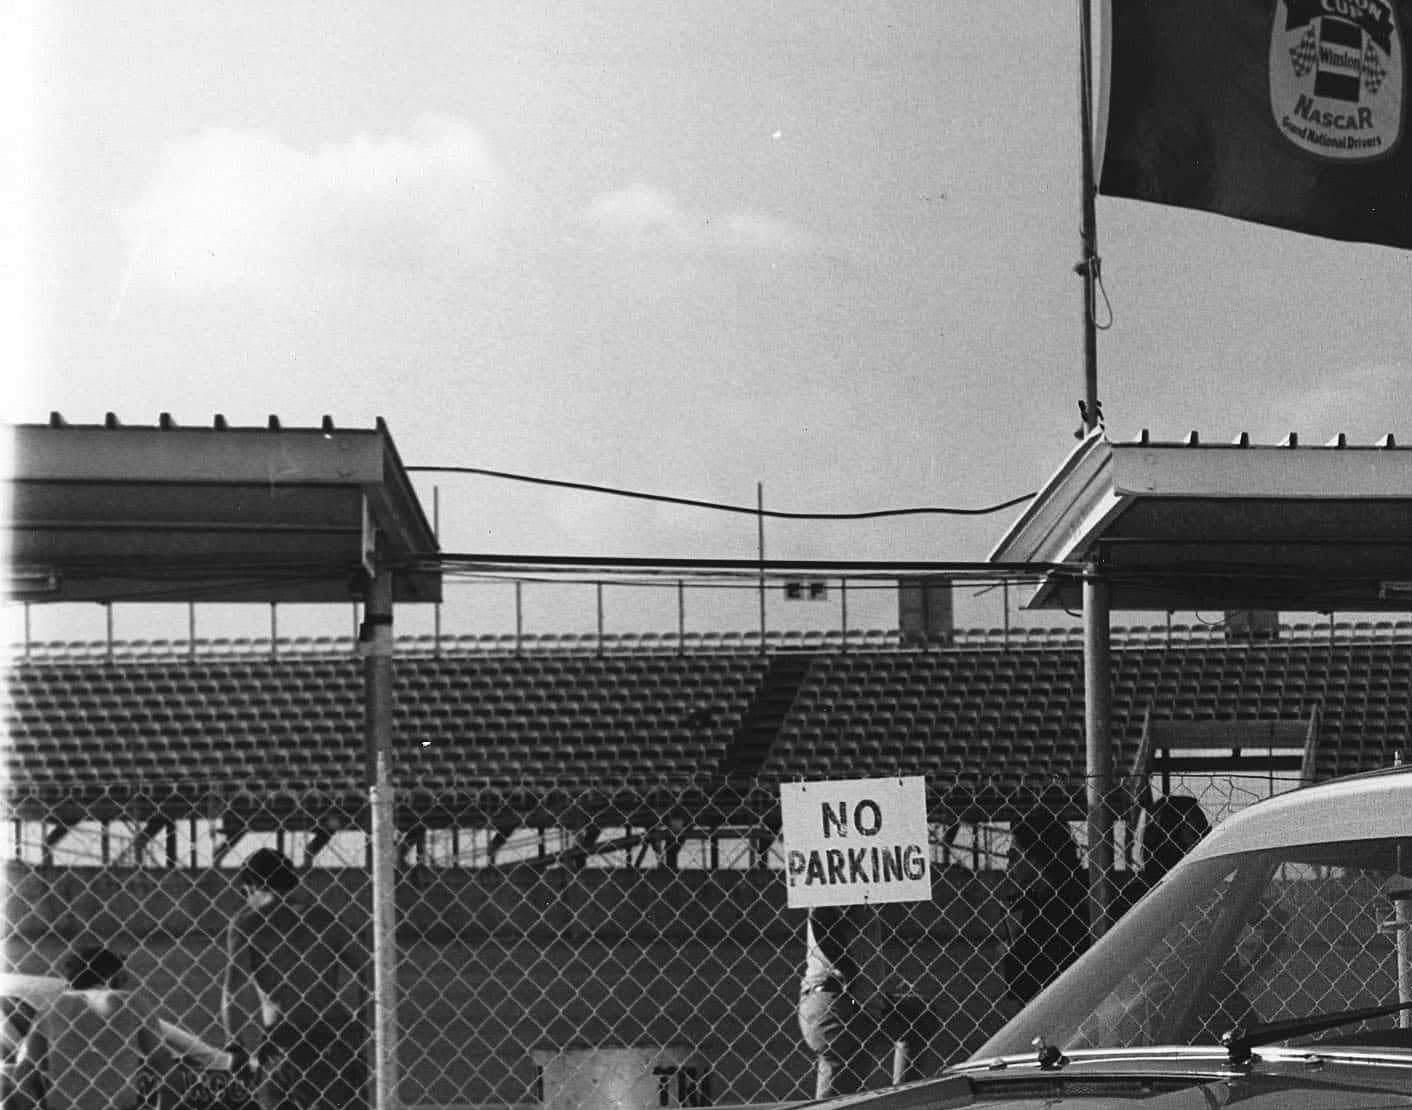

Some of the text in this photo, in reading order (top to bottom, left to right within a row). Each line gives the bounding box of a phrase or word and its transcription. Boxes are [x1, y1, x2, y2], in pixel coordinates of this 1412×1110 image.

[1320, 47, 1361, 70] Winston
[1294, 93, 1373, 129] NASCAR
[1283, 115, 1382, 149] Grand National Drivers
[821, 799, 882, 838] NO
[788, 845, 926, 887] PARKING
